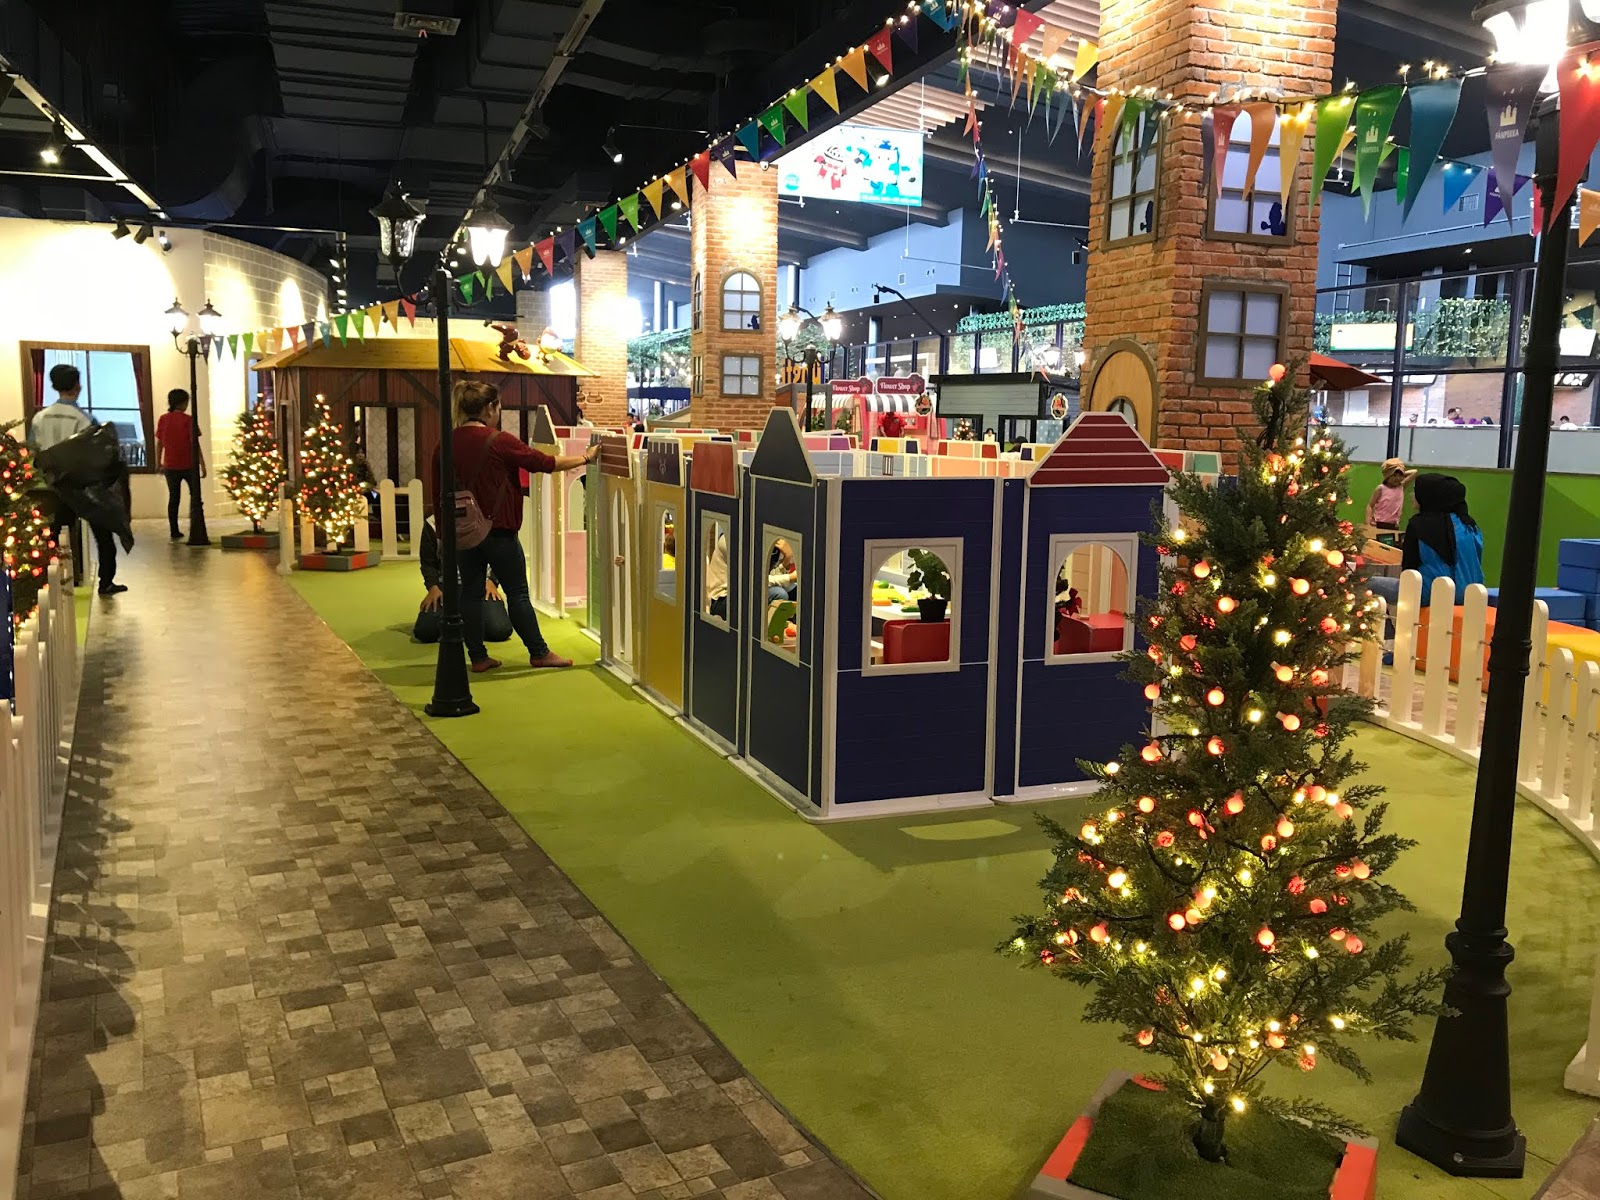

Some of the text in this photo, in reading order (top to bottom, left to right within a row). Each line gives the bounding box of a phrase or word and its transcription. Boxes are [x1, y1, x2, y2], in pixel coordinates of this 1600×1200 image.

[848, 385, 861, 393] Shop
[880, 382, 911, 391] Flower Shop
